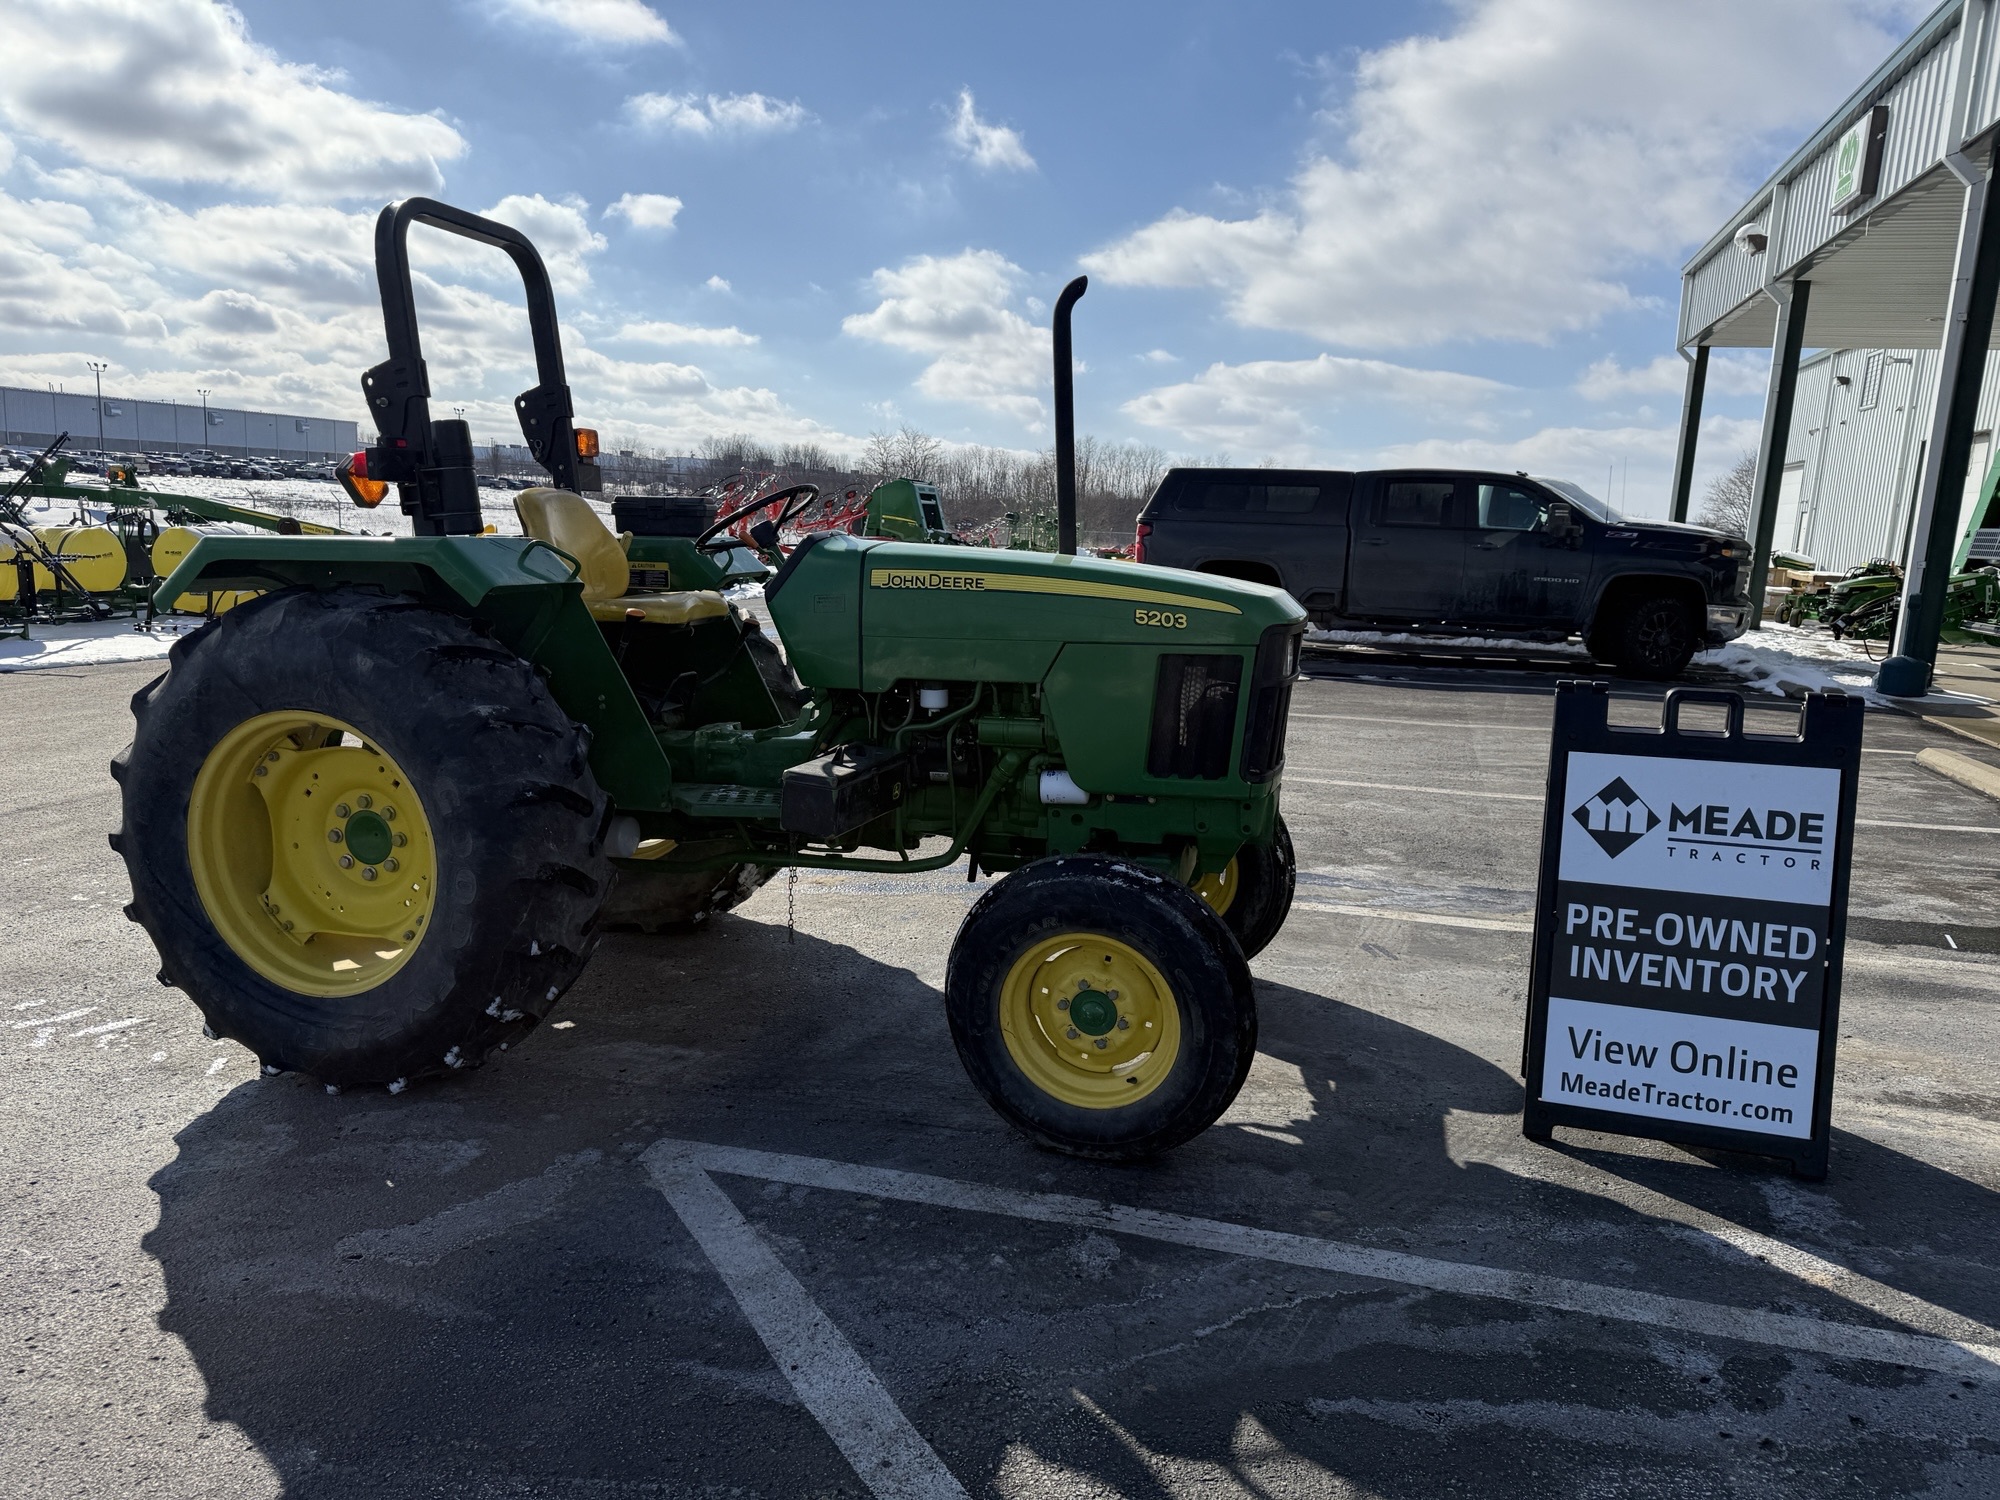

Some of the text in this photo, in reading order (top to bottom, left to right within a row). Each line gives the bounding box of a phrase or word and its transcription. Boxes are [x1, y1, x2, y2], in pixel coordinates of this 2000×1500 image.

[882, 573, 985, 589] JOHN DEERE
[1135, 609, 1188, 629] 5203
[1668, 802, 1825, 845] MEADE
[1666, 846, 1821, 871] TRACTOR
[1566, 903, 1817, 961] PRE-OWNED
[1569, 945, 1809, 1004] INVENTORY
[1568, 1026, 1799, 1089] View Online
[1560, 1072, 1793, 1125] MeadeTractor.com
